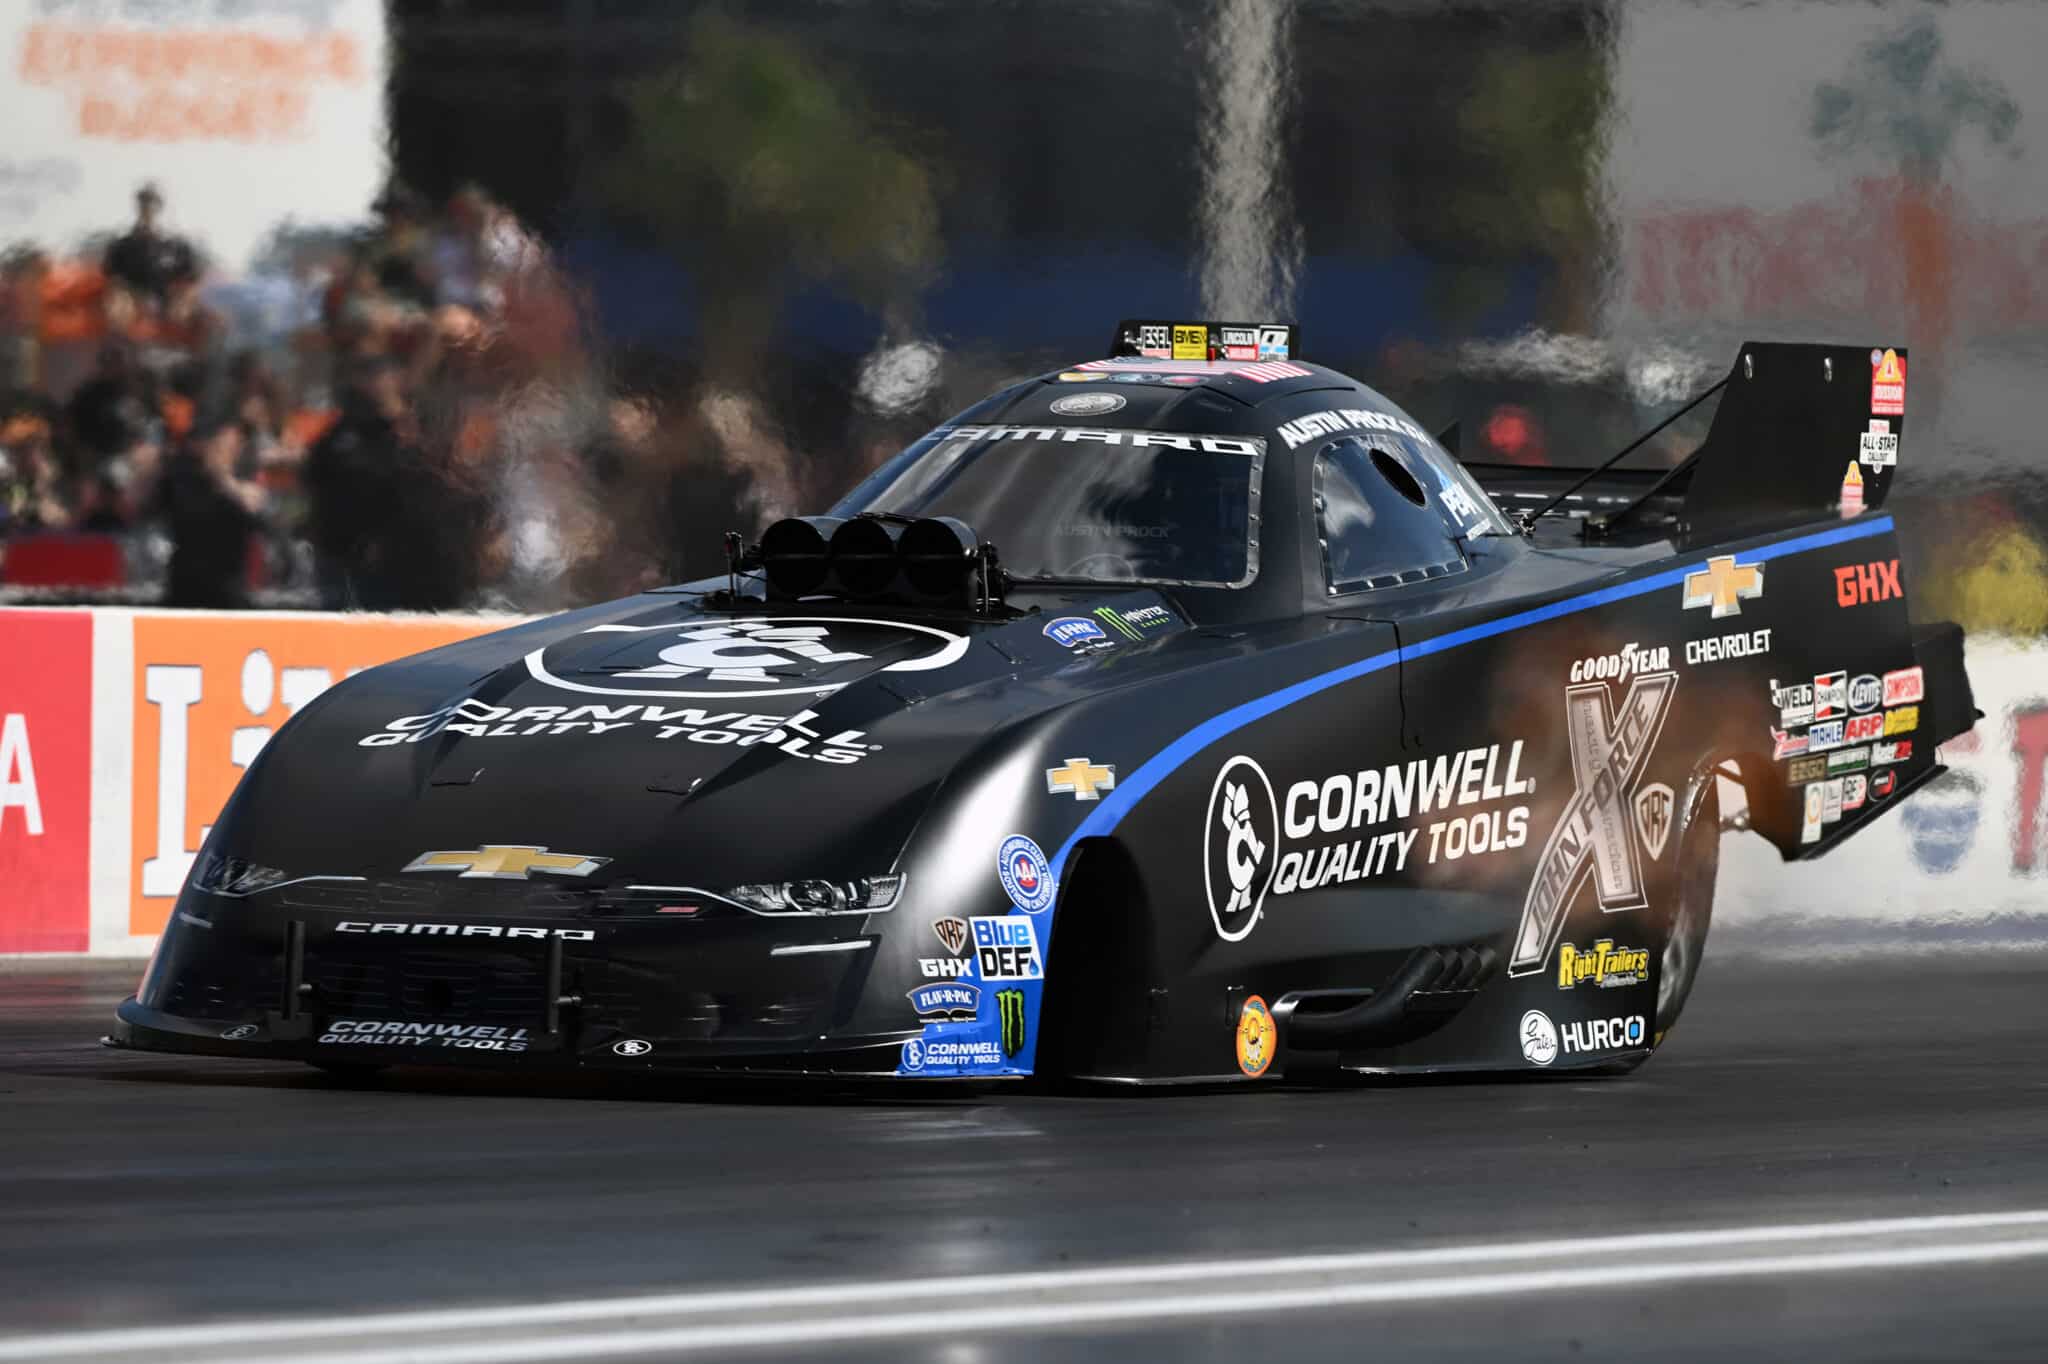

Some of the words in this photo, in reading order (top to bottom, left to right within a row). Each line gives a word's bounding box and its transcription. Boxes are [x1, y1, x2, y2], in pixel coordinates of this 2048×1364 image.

[1277, 410, 1350, 450] AUSTIN
[1833, 559, 1904, 608] GHX
[1686, 628, 1772, 666] CHEVROLET
[1570, 642, 1670, 684] GOODYEAR
[385, 697, 871, 752] CORNWELL
[1811, 724, 1842, 746] MAHLE
[1845, 714, 1882, 741] ARP
[358, 721, 635, 747] QUALITY
[654, 725, 868, 765] TOOLS
[1284, 739, 1525, 839] CORNWELL
[1533, 823, 1582, 947] JOHN
[1579, 702, 1649, 835] FORCE
[1273, 827, 1418, 894] QUALITY
[1428, 806, 1530, 864] TOOLS
[1015, 860, 1039, 881] AAA
[335, 921, 595, 941] CAMARO
[973, 919, 1032, 946] Blue
[918, 959, 974, 977] GHX
[979, 946, 1033, 977] DEF
[318, 1034, 432, 1046] QUALITY
[441, 1036, 529, 1052] TOOLS
[328, 1020, 529, 1041] CORNWELL
[1560, 1016, 1645, 1053] HURCO
[926, 1054, 970, 1066] QUALITY
[973, 1053, 1001, 1064] TOOLS
[928, 1041, 1001, 1055] CORNWELL
